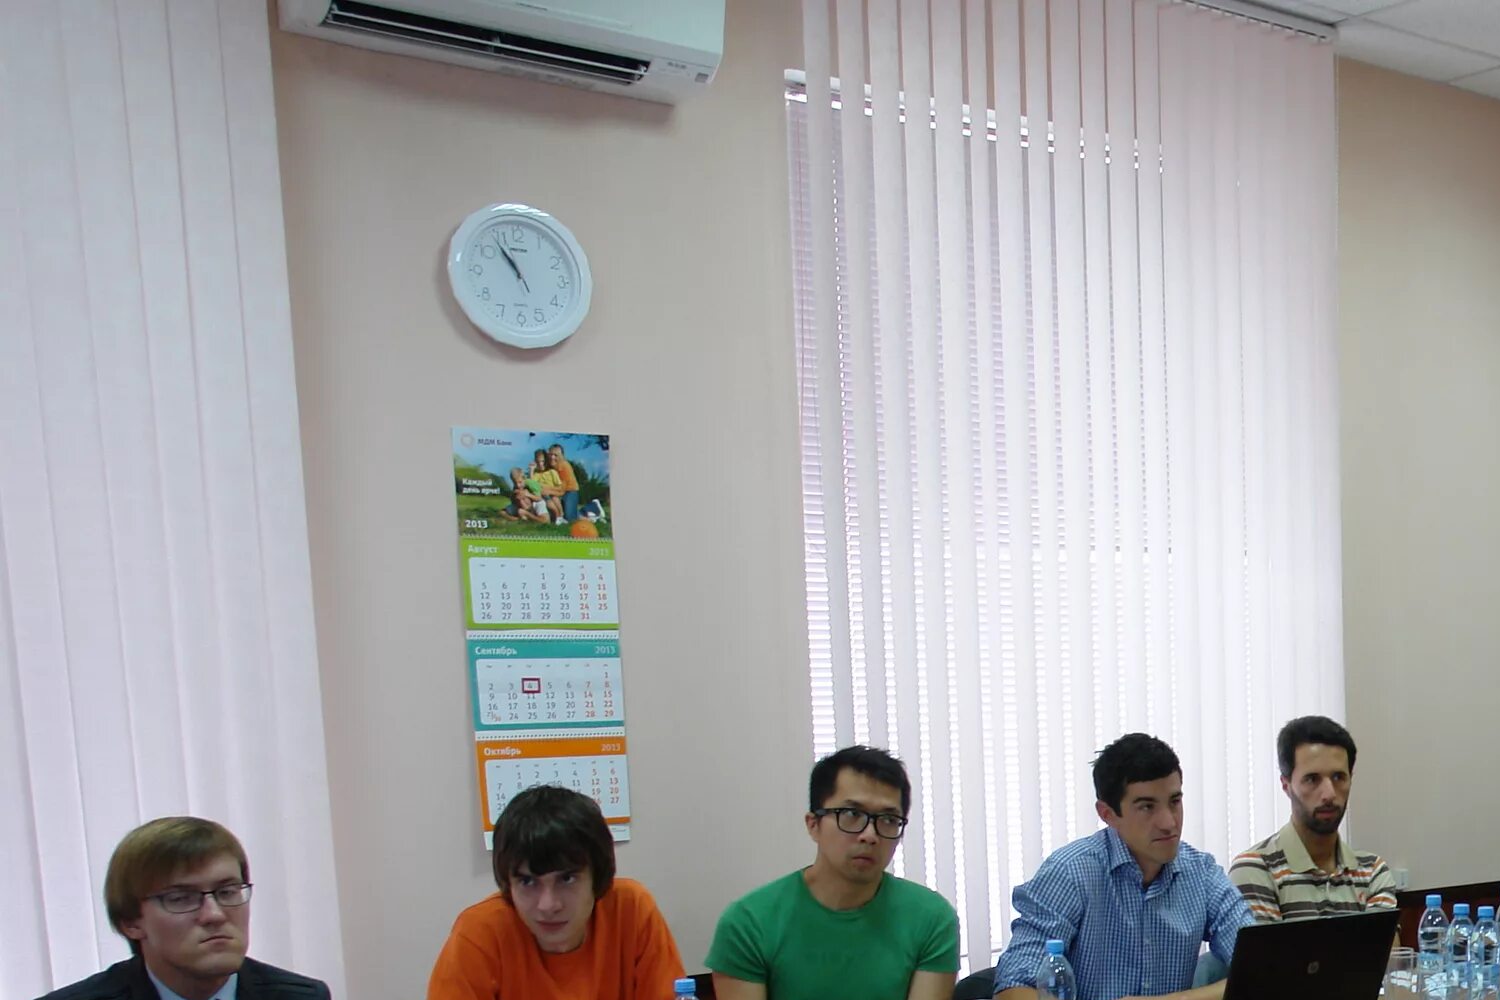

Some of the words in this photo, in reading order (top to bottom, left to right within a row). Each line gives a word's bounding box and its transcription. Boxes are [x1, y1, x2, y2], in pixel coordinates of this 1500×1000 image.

[462, 478, 493, 486] Каждый
[465, 520, 488, 528] 2013
[580, 573, 585, 581] 3
[481, 612, 492, 620] 26
[521, 612, 532, 620] 28
[475, 646, 517, 656] Сентябрь
[595, 646, 616, 654] 2013
[484, 747, 521, 756] Октябрь
[517, 772, 522, 780] 1
